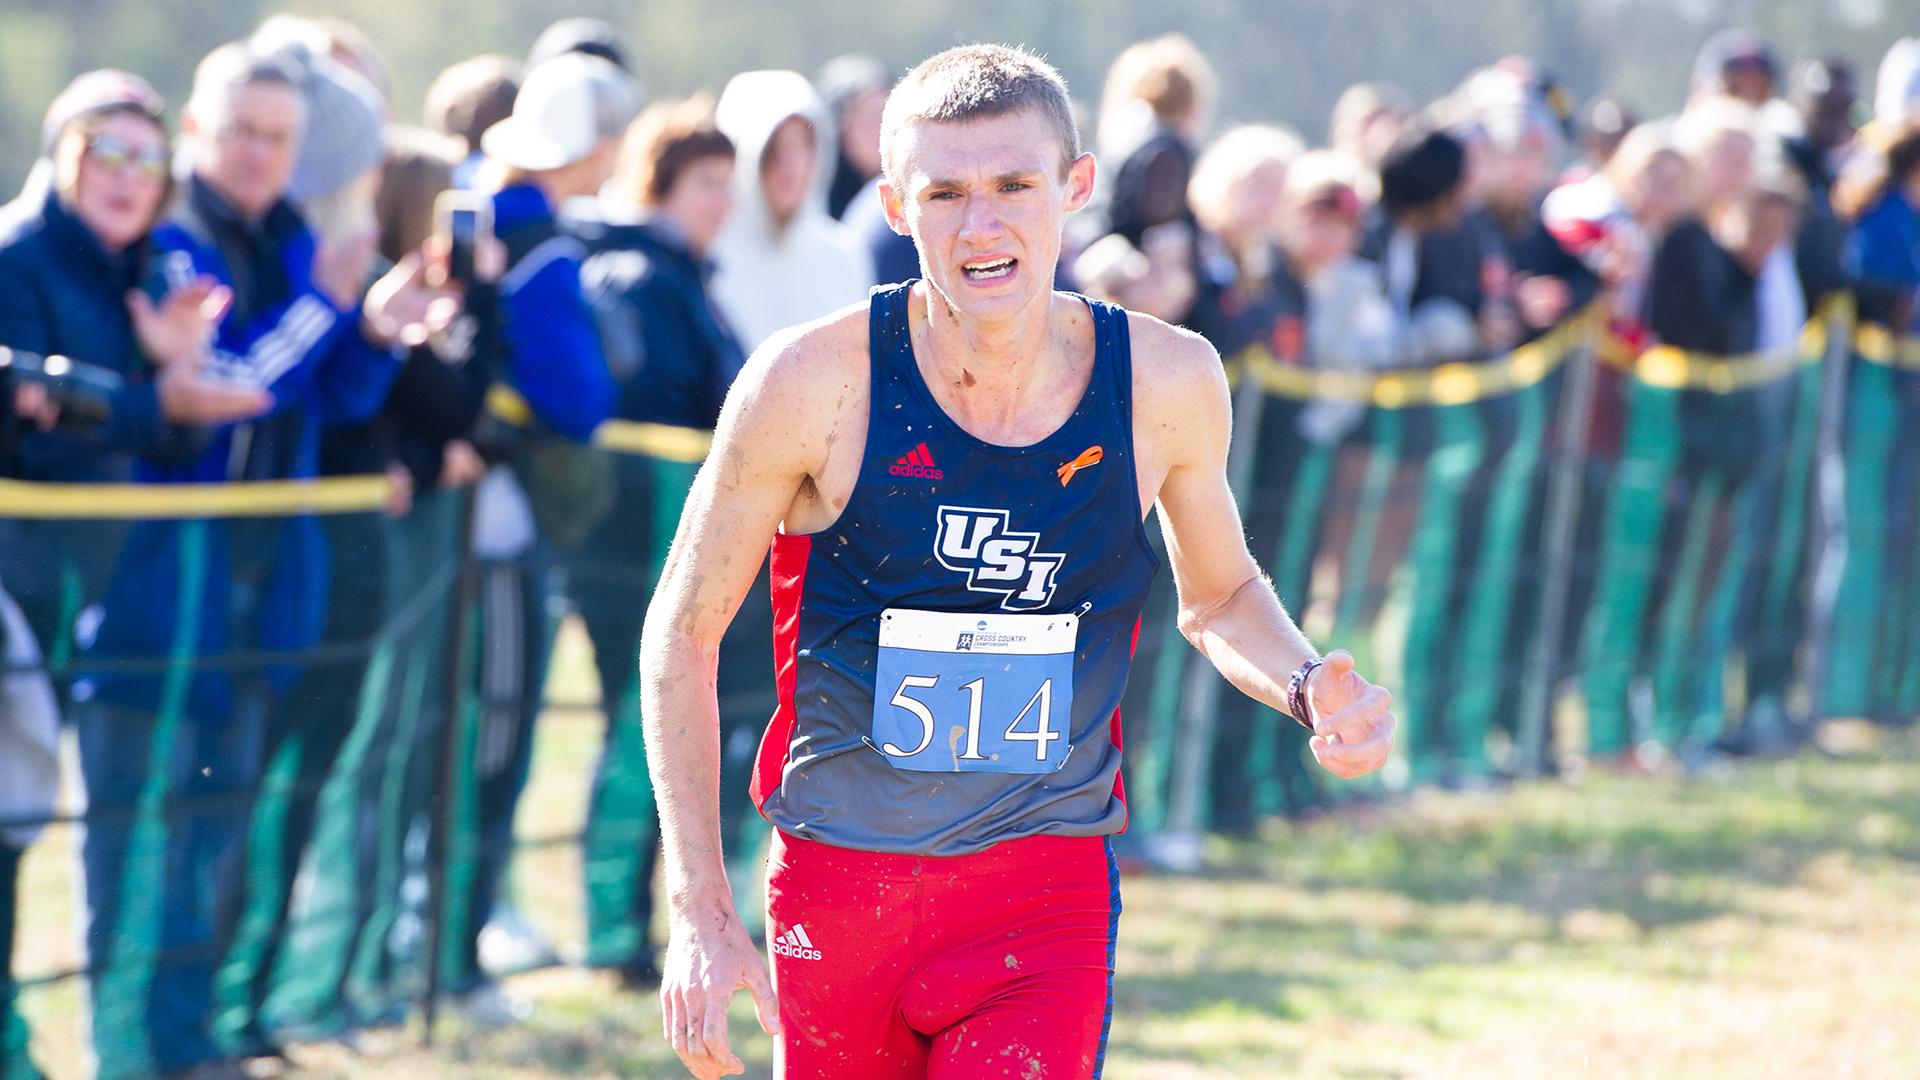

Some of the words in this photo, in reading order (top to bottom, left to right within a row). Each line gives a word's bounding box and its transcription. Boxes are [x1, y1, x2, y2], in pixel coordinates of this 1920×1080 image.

[889, 464, 943, 479] adidas
[940, 512, 1058, 602] USI
[997, 635, 1027, 643] COUNTRY
[882, 673, 1060, 761] 514
[773, 943, 822, 961] adidas
